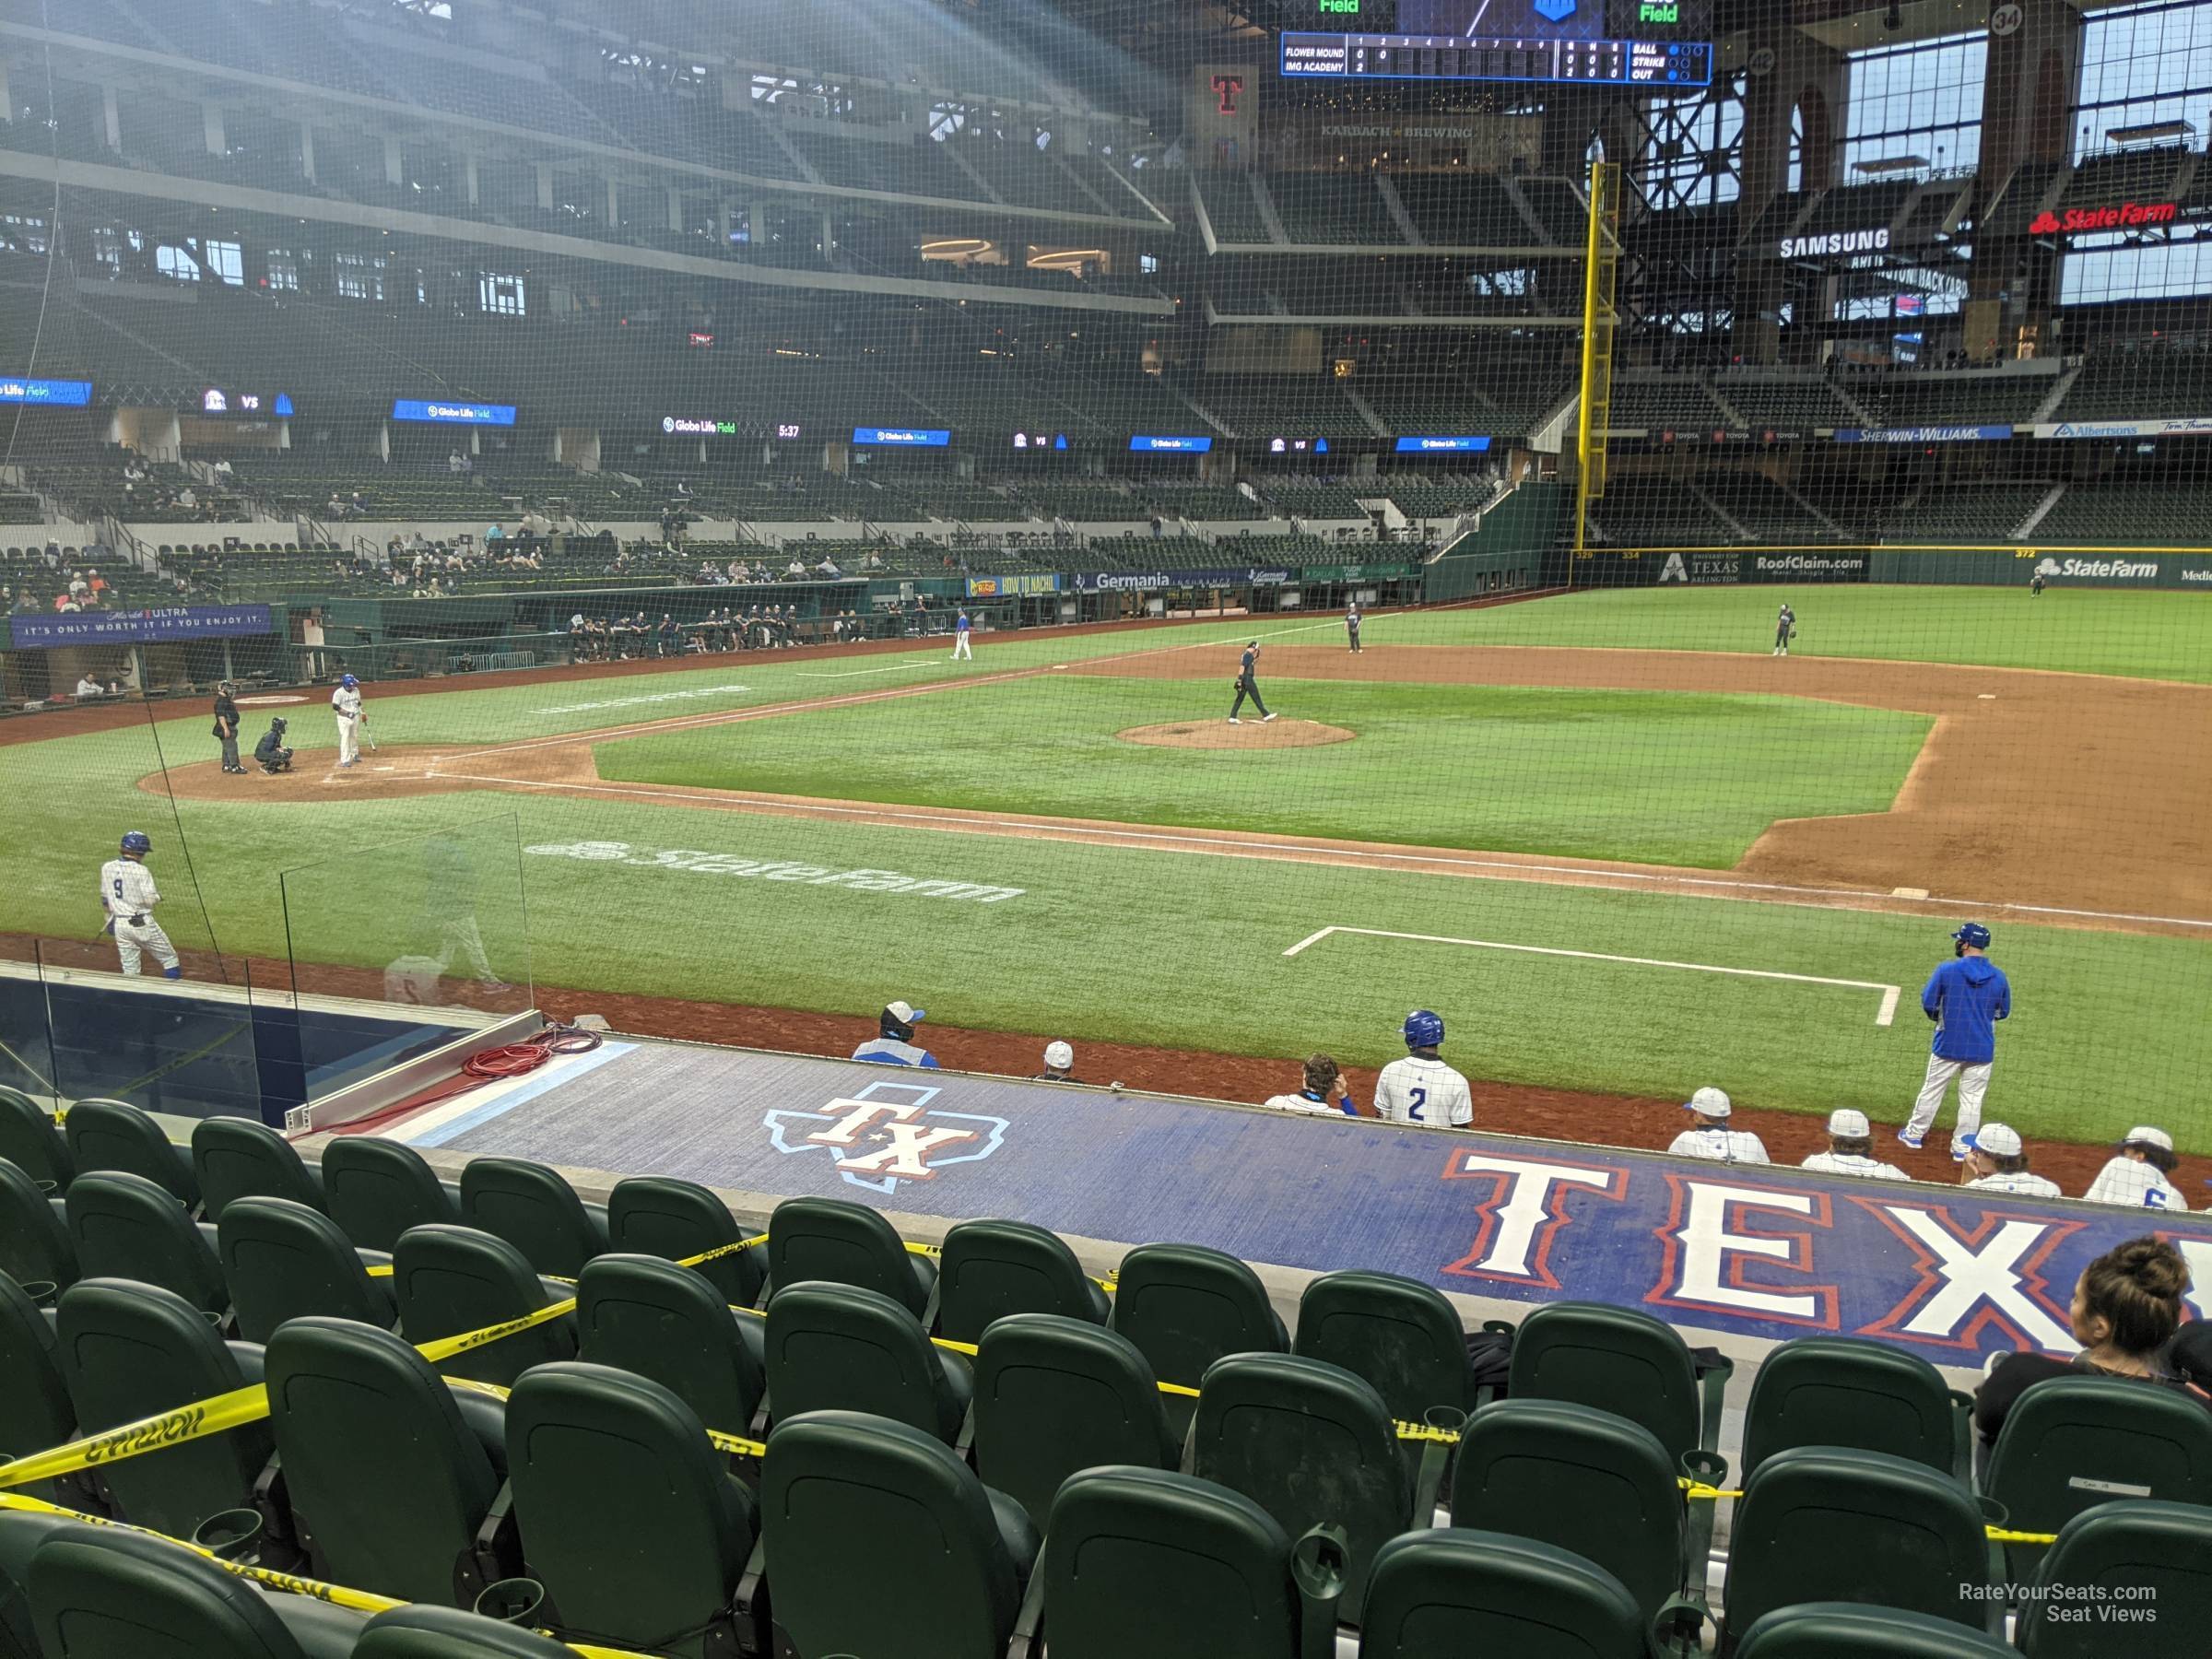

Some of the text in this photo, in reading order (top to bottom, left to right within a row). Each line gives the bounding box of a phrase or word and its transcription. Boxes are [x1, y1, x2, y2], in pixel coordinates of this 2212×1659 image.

[1319, 0, 1359, 13] Field
[1640, 5, 1678, 22] Field
[1994, 11, 2020, 29] 34
[1633, 43, 1656, 55] BALL
[1286, 48, 1618, 65] FLOWER MOUND 0 0 0 0 1
[1632, 56, 1665, 68] STRIKE
[1286, 62, 1618, 78] IMG ACADEMY 2 2 0 0
[1632, 70, 1653, 80] OUT
[1321, 125, 1476, 138] KARBACH BREWING
[1781, 229, 1889, 258] SAMSUNG
[241, 395, 259, 408] VS
[438, 406, 460, 418] Globe
[460, 407, 474, 418] Life
[676, 418, 735, 434] Globe Life Field
[779, 425, 799, 438] 5:37
[2076, 426, 2137, 437] Albertsons
[1036, 436, 1046, 446] VS
[1295, 441, 1306, 449] VS
[1577, 551, 1594, 559] 329
[2015, 549, 2036, 559] 372
[1692, 561, 1739, 573] TEXAS
[1757, 555, 1864, 570] RoofClaim.com
[1002, 575, 1055, 594] HOW TO NACHO.
[1096, 571, 1170, 589] Germania
[152, 607, 189, 618] ULTRA
[24, 627, 50, 636] IT'S
[57, 624, 88, 634] ONLY
[95, 622, 137, 632] WORTH
[144, 620, 155, 629] IT
[161, 619, 173, 628] IF
[178, 618, 200, 628] YOU
[206, 617, 241, 626] ENJOY
[113, 878, 123, 900] 9
[1408, 1087, 1427, 1122] 2
